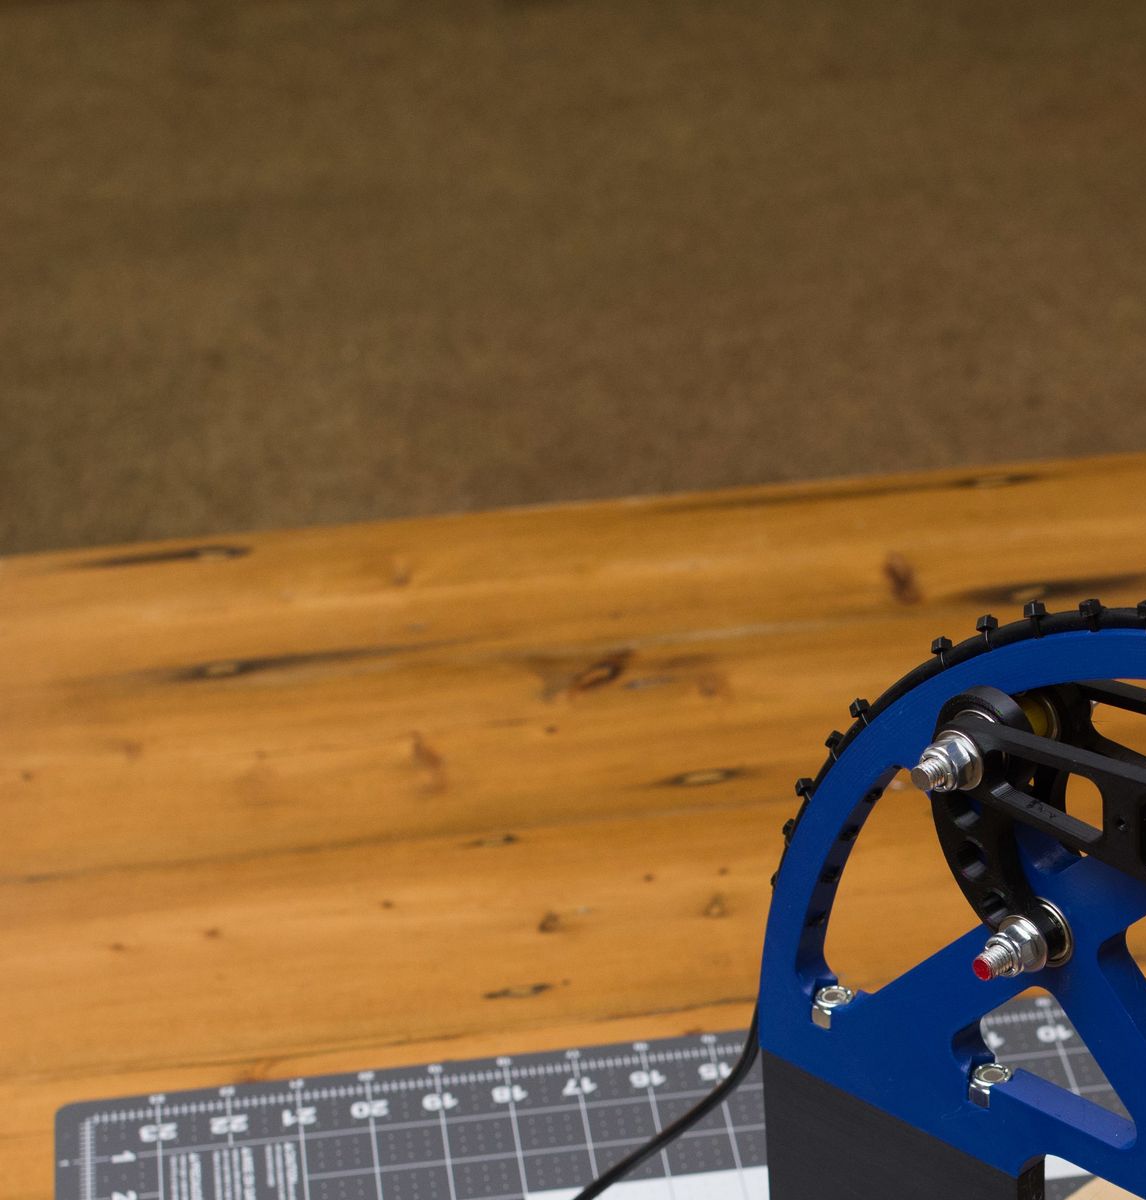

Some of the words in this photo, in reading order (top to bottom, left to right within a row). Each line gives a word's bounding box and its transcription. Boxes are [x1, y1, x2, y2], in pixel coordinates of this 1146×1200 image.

[562, 1077, 597, 1096] 17
[629, 1069, 667, 1088] 16
[351, 1099, 389, 1119] 20
[422, 1092, 459, 1111] 19
[210, 1114, 248, 1135] 22
[281, 1106, 317, 1127] 21
[139, 1122, 178, 1143] 23
[112, 1150, 136, 1164] 1
